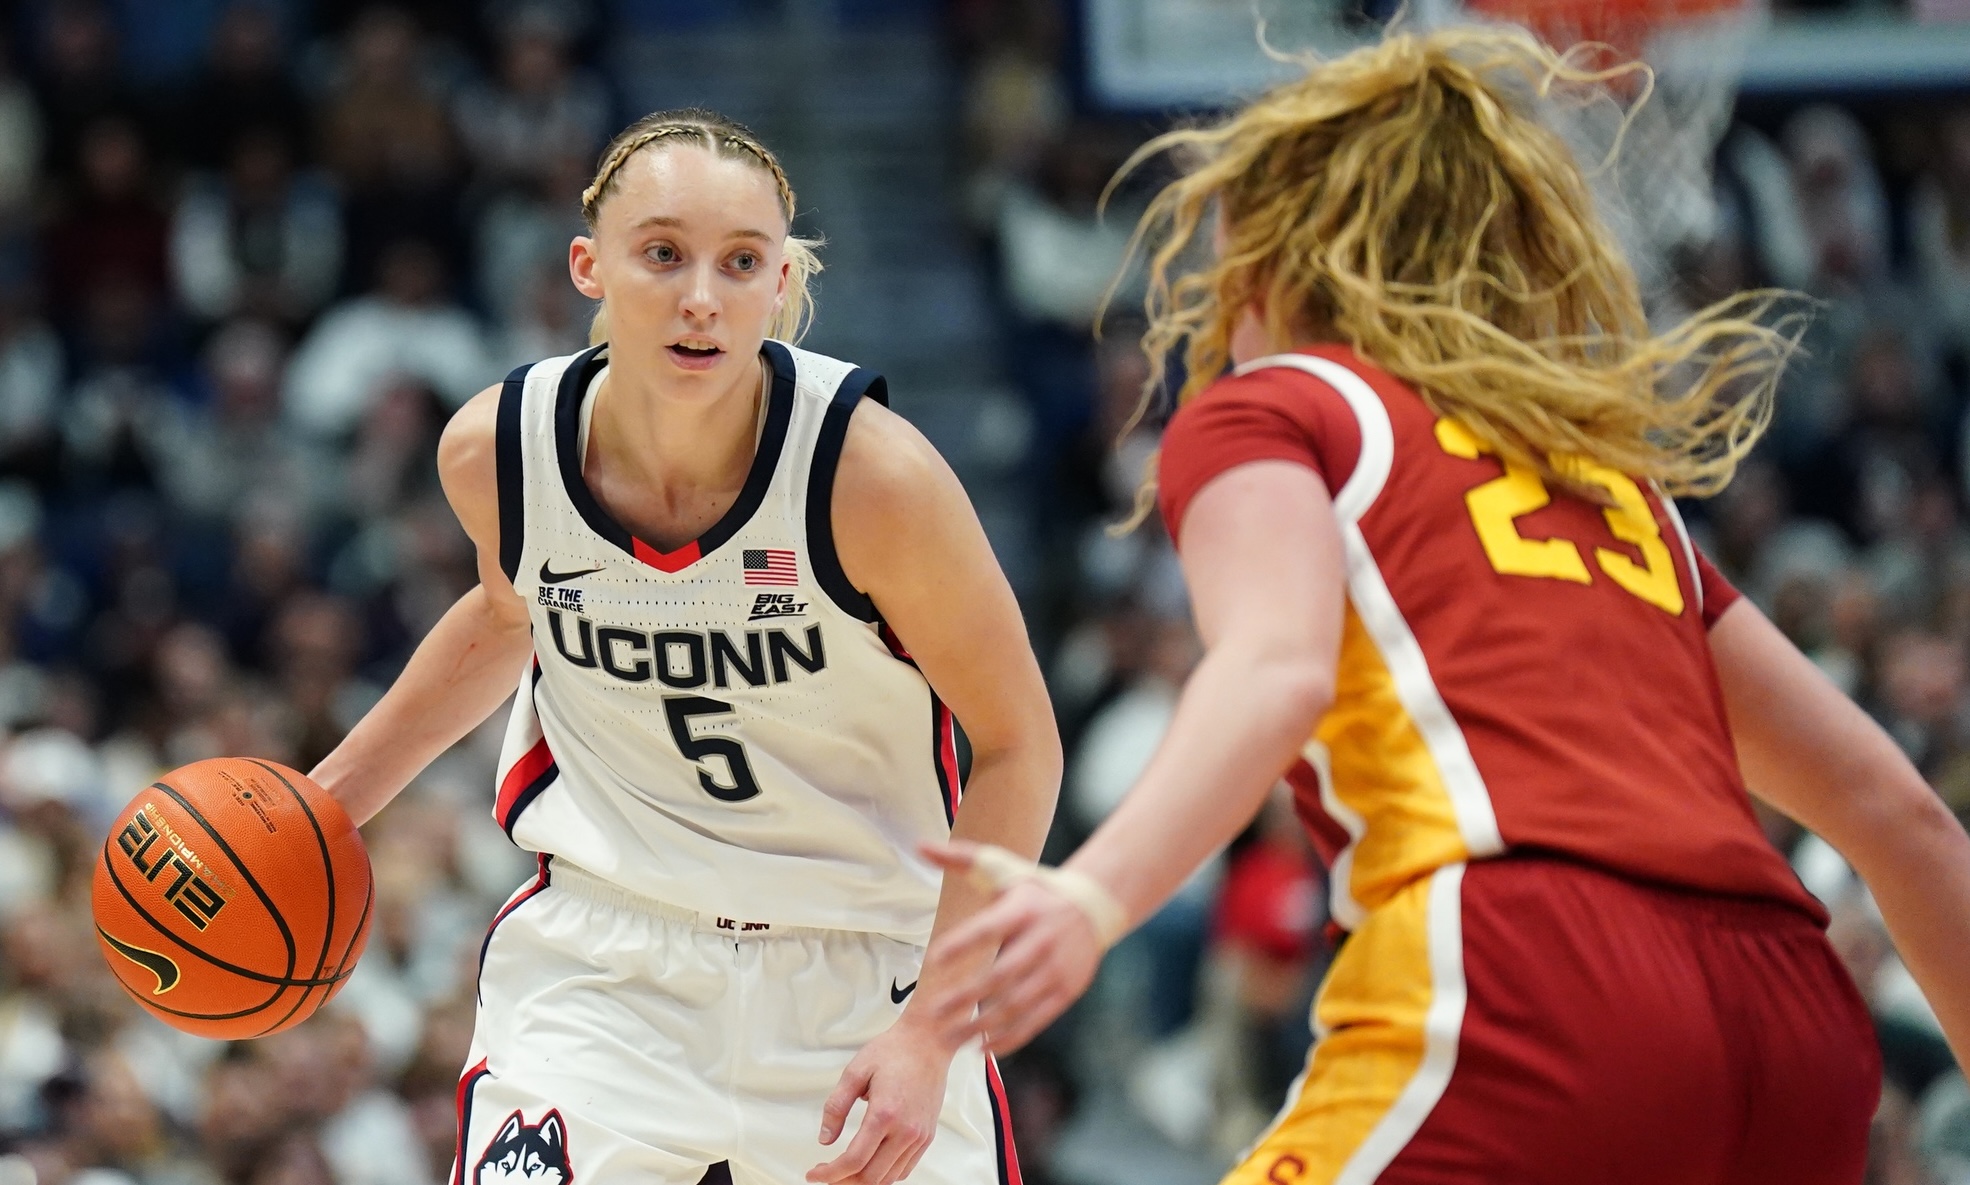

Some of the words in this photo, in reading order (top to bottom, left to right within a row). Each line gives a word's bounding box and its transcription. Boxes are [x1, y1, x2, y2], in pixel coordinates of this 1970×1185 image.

[1434, 416, 1685, 617] 23
[537, 596, 585, 614] CHANGE
[539, 586, 555, 600] BE
[558, 588, 583, 603] THE
[751, 603, 809, 615] EAST
[755, 594, 795, 604] BIG
[546, 606, 828, 689] UCONN
[661, 694, 763, 804] 5
[117, 808, 228, 933] ELITE
[144, 802, 238, 899] CHAMPIONSHIP
